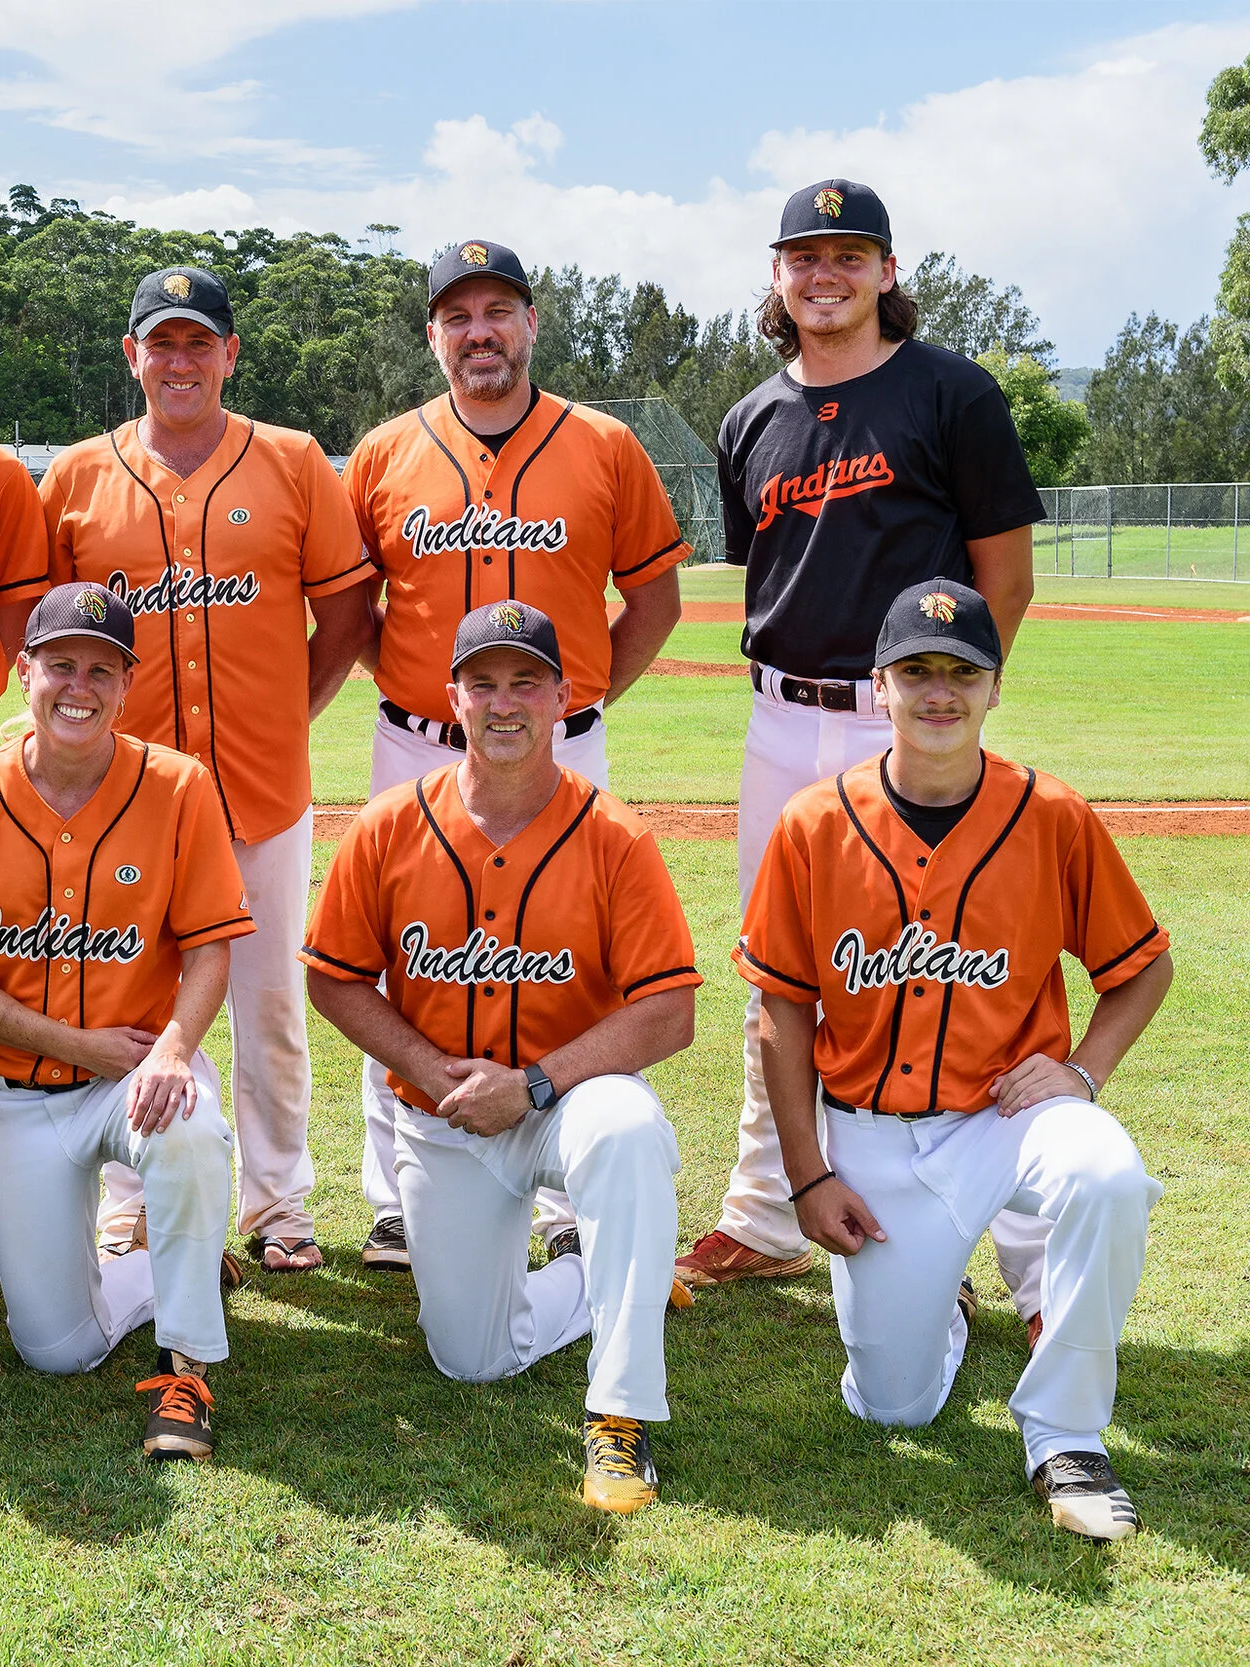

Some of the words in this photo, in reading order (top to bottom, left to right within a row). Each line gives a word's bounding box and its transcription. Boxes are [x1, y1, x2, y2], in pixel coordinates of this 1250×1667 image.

[754, 450, 894, 530] Indians
[403, 505, 566, 557] Indians
[107, 562, 259, 611] Indians
[400, 922, 576, 984] Indians
[832, 923, 1010, 993] Indians
